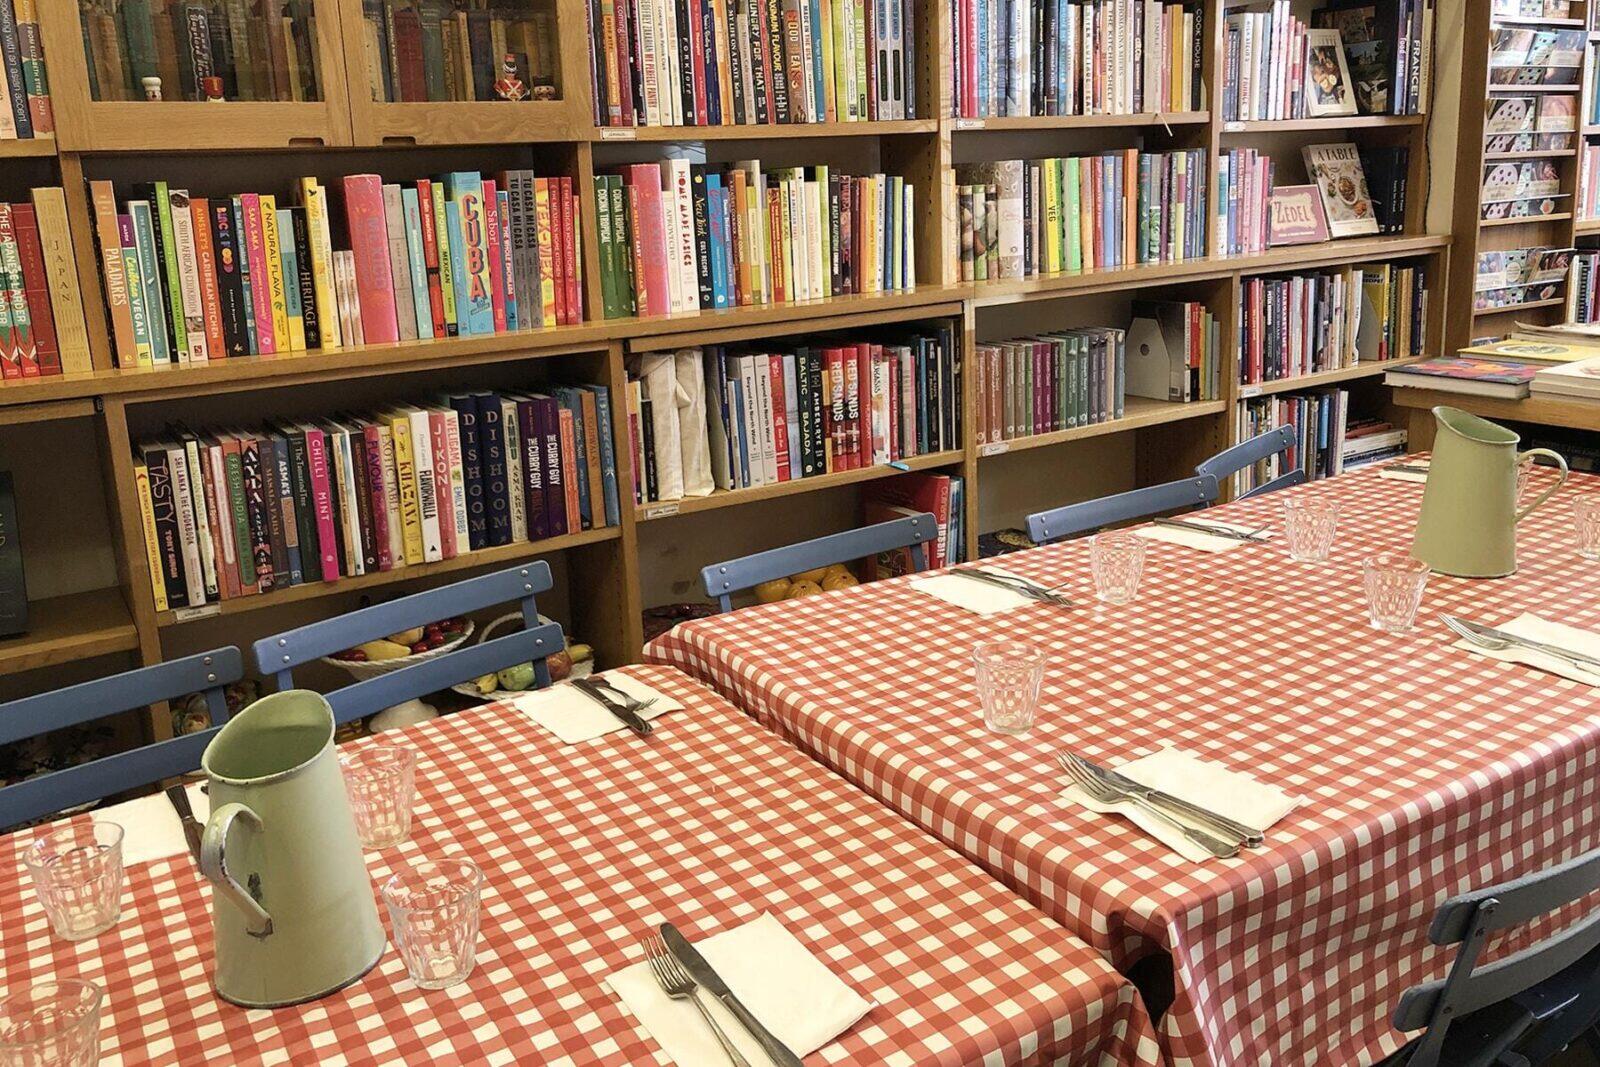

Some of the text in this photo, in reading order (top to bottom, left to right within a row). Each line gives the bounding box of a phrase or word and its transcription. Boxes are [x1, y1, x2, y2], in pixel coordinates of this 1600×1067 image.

[772, 35, 781, 71] FLAVOUR
[787, 10, 799, 42] GOOD
[6, 34, 27, 122] with an asian accent
[645, 54, 657, 108] MY PERFECT PANTRY
[753, 41, 765, 91] FOR THAT
[1411, 40, 1421, 96] FRANCE!
[1326, 147, 1357, 160] TABLE
[0, 209, 9, 229] THE
[249, 207, 259, 251] SAKA SAKA
[488, 210, 499, 245] Sabor!
[510, 179, 523, 249] TU CASA MI CASA
[523, 178, 536, 248] TU CASA MI CASA
[564, 201, 572, 232] MEXICAN
[597, 189, 610, 244] COCINA TROPICAL
[612, 189, 625, 244] COCINA TROPICAL
[678, 171, 691, 266] HOME MADE BASICS
[694, 194, 705, 217] New
[697, 218, 707, 236] York
[1048, 206, 1056, 222] VEG
[2, 232, 19, 285] JAPANESE
[53, 241, 70, 302] JAPAN
[178, 220, 198, 314] SOUTH AFRICAN COOKBOOK
[197, 208, 218, 338] AINSLEY'S CARIBBEAN KITCHEN
[221, 241, 234, 273] FOOD
[265, 212, 281, 297] NATURAL FLAVA
[442, 251, 450, 284] MEXICAN
[463, 195, 488, 303] CUBA
[12, 282, 26, 322] LARDER
[105, 248, 126, 306] PALADARES
[300, 272, 316, 327] HERITAGE
[132, 299, 144, 335] VEGAN
[799, 357, 810, 455] BALTIC BAJADA
[831, 361, 843, 421] RED SANDS
[847, 359, 858, 419] RED SANDS
[278, 461, 290, 495] ASMA'S
[296, 461, 305, 493] Tamarind
[312, 439, 329, 522] CHILLI MINT
[368, 440, 381, 492] FLAVOUR
[383, 433, 398, 514] EXOTIC TABLE
[434, 424, 448, 498] JIKONI
[447, 417, 466, 534] WELIGAMA EMILY DOBBS
[463, 413, 485, 531] DISHOOM
[486, 411, 508, 528] DISHOOM
[528, 438, 541, 489] THE CURRY GUY
[547, 443, 559, 468] CURRY
[550, 470, 560, 485] GUY
[150, 459, 176, 551] TASTY TONY
[175, 457, 194, 546] SRI LANKA THE COOKBOOK
[230, 458, 244, 524] FRESH INDIA
[400, 462, 417, 527] KHAZANA
[419, 470, 436, 519] FLAVORWALLA
[937, 523, 946, 558] RUSSIA
